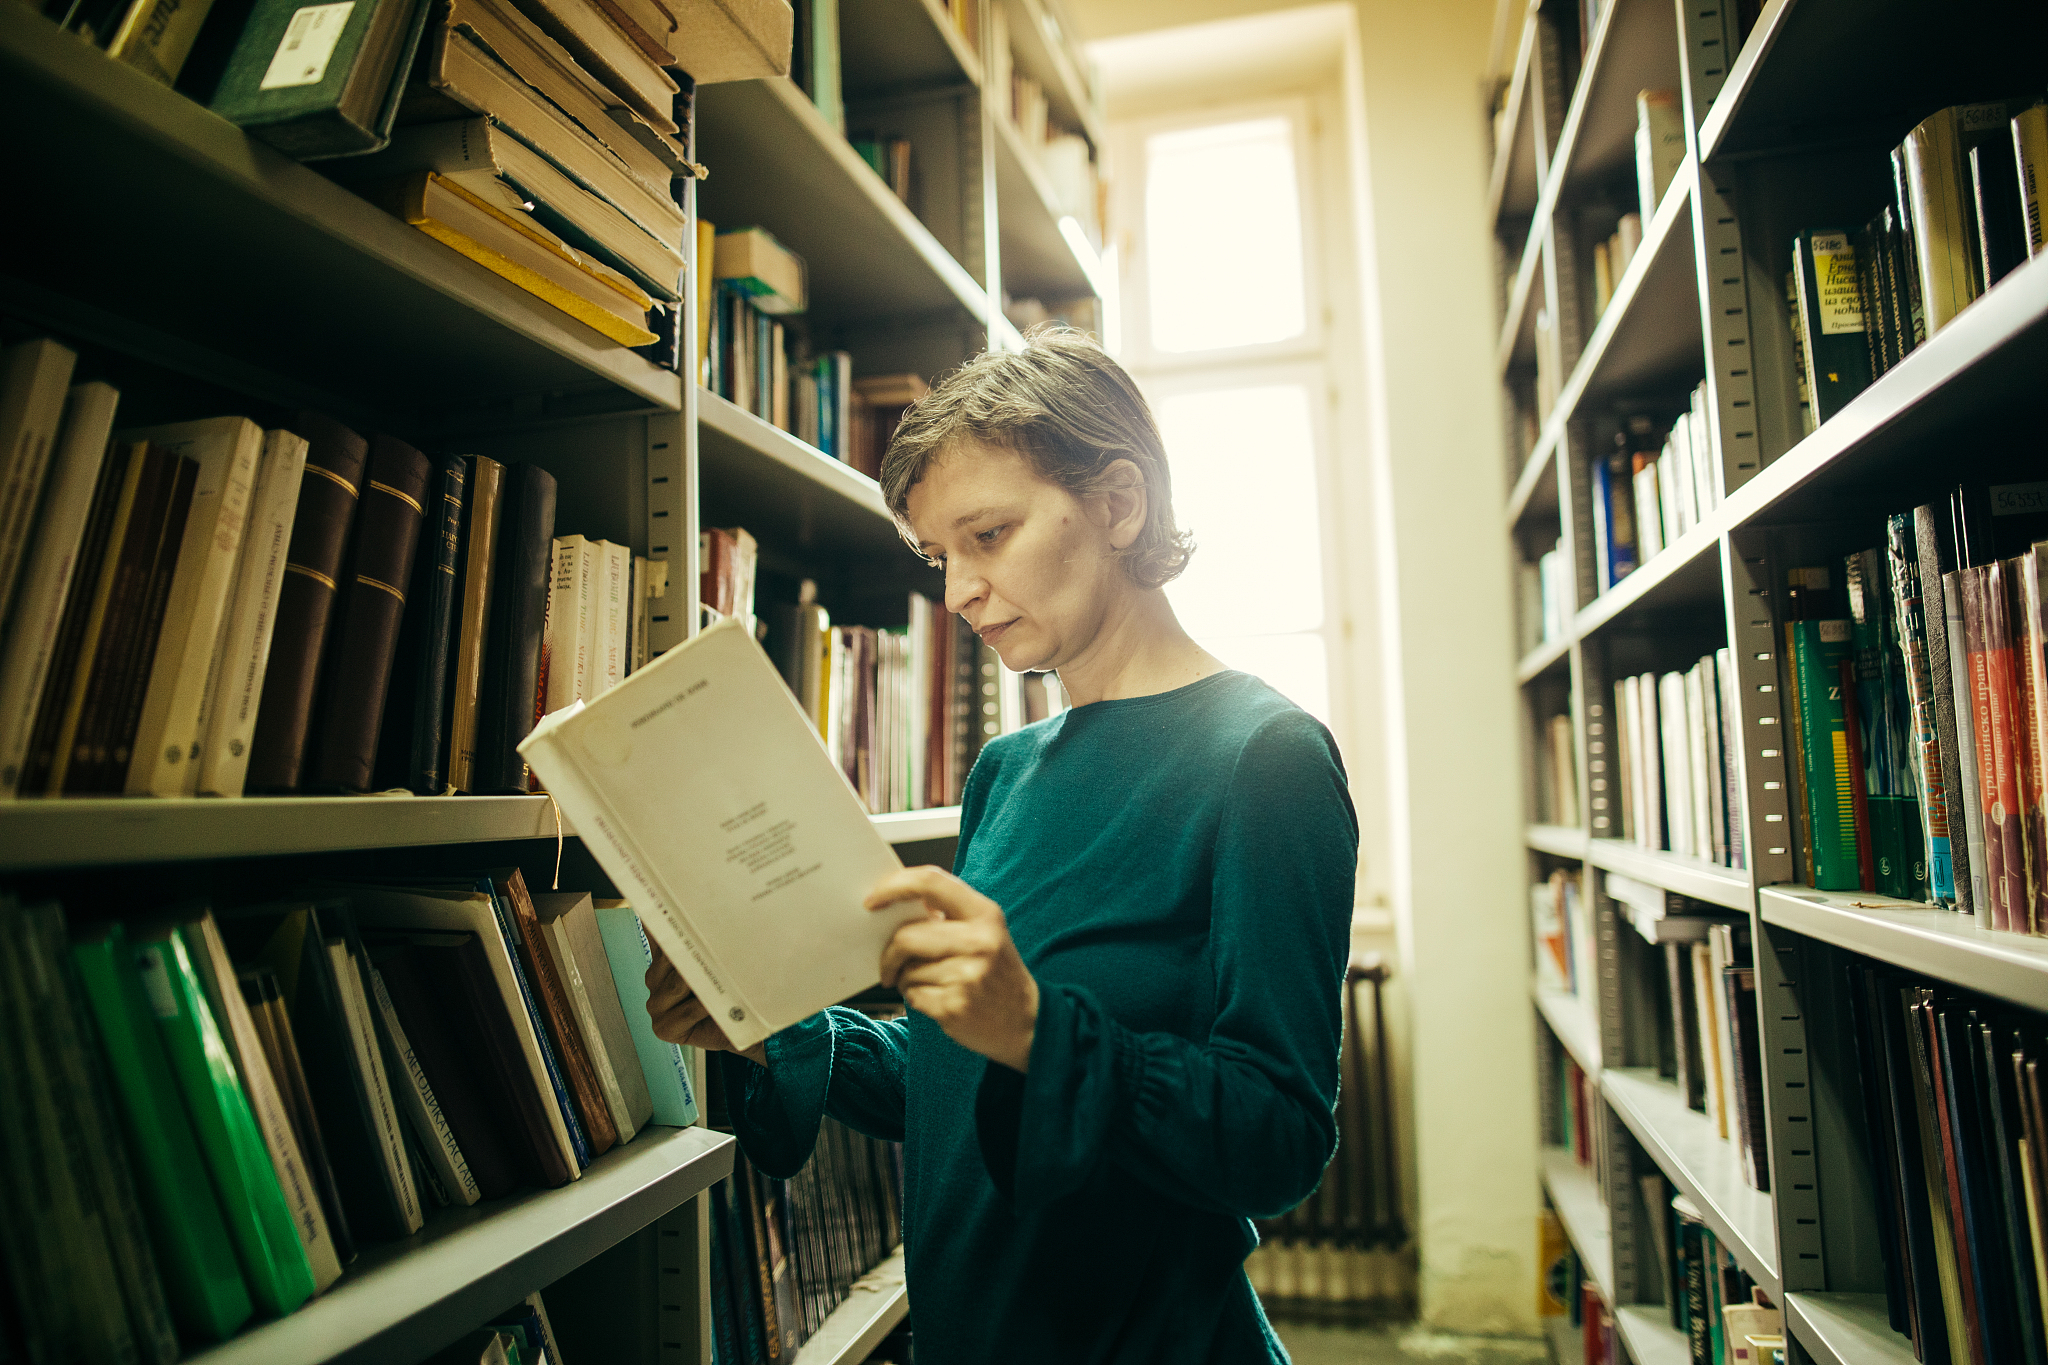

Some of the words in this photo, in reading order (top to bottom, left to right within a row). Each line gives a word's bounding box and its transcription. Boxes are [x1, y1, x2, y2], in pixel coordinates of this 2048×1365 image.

[1868, 348, 1879, 380] ТОРИЈА
[1879, 338, 1890, 371] ТОРИЈА
[1895, 330, 1906, 358] ОРИЈА
[1973, 653, 1990, 700] право
[1991, 692, 2002, 723] право
[1977, 705, 1998, 798] трговинско
[524, 915, 556, 992] MATEMATIKA
[400, 1048, 451, 1132] МЕТОДИКА
[439, 1130, 480, 1195] НАСТАВЕ
